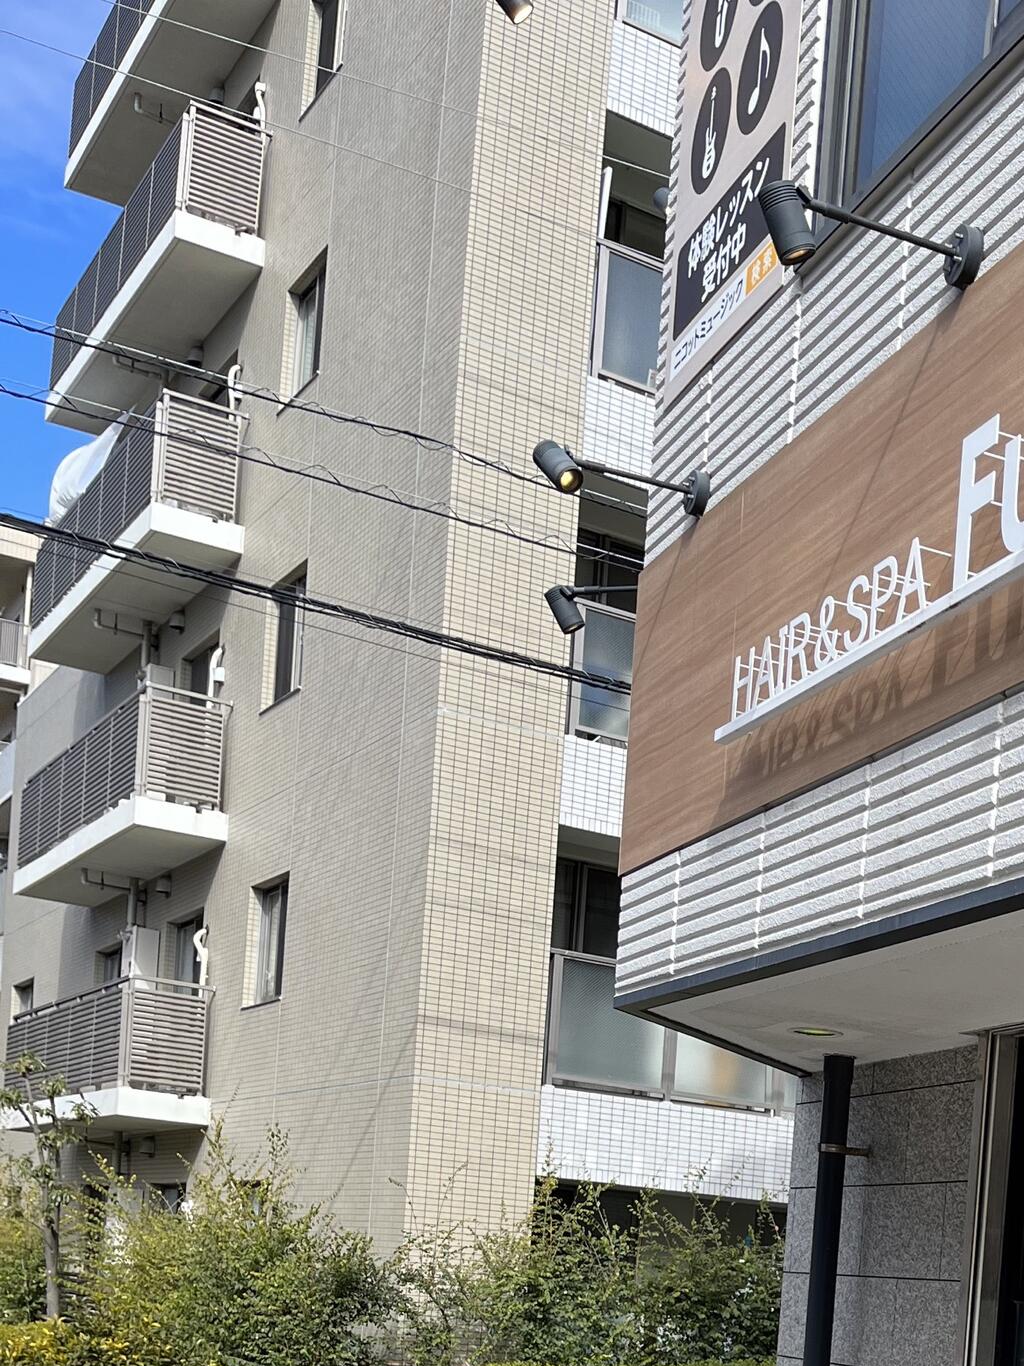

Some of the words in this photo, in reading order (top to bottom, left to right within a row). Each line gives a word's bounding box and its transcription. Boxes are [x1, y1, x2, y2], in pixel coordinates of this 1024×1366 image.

[687, 157, 770, 279] 体験レッスン
[701, 222, 747, 303] 受付中
[750, 247, 778, 286] 検索
[674, 278, 743, 370] ニコットミュージック
[730, 536, 927, 722] HAIR&SPA
